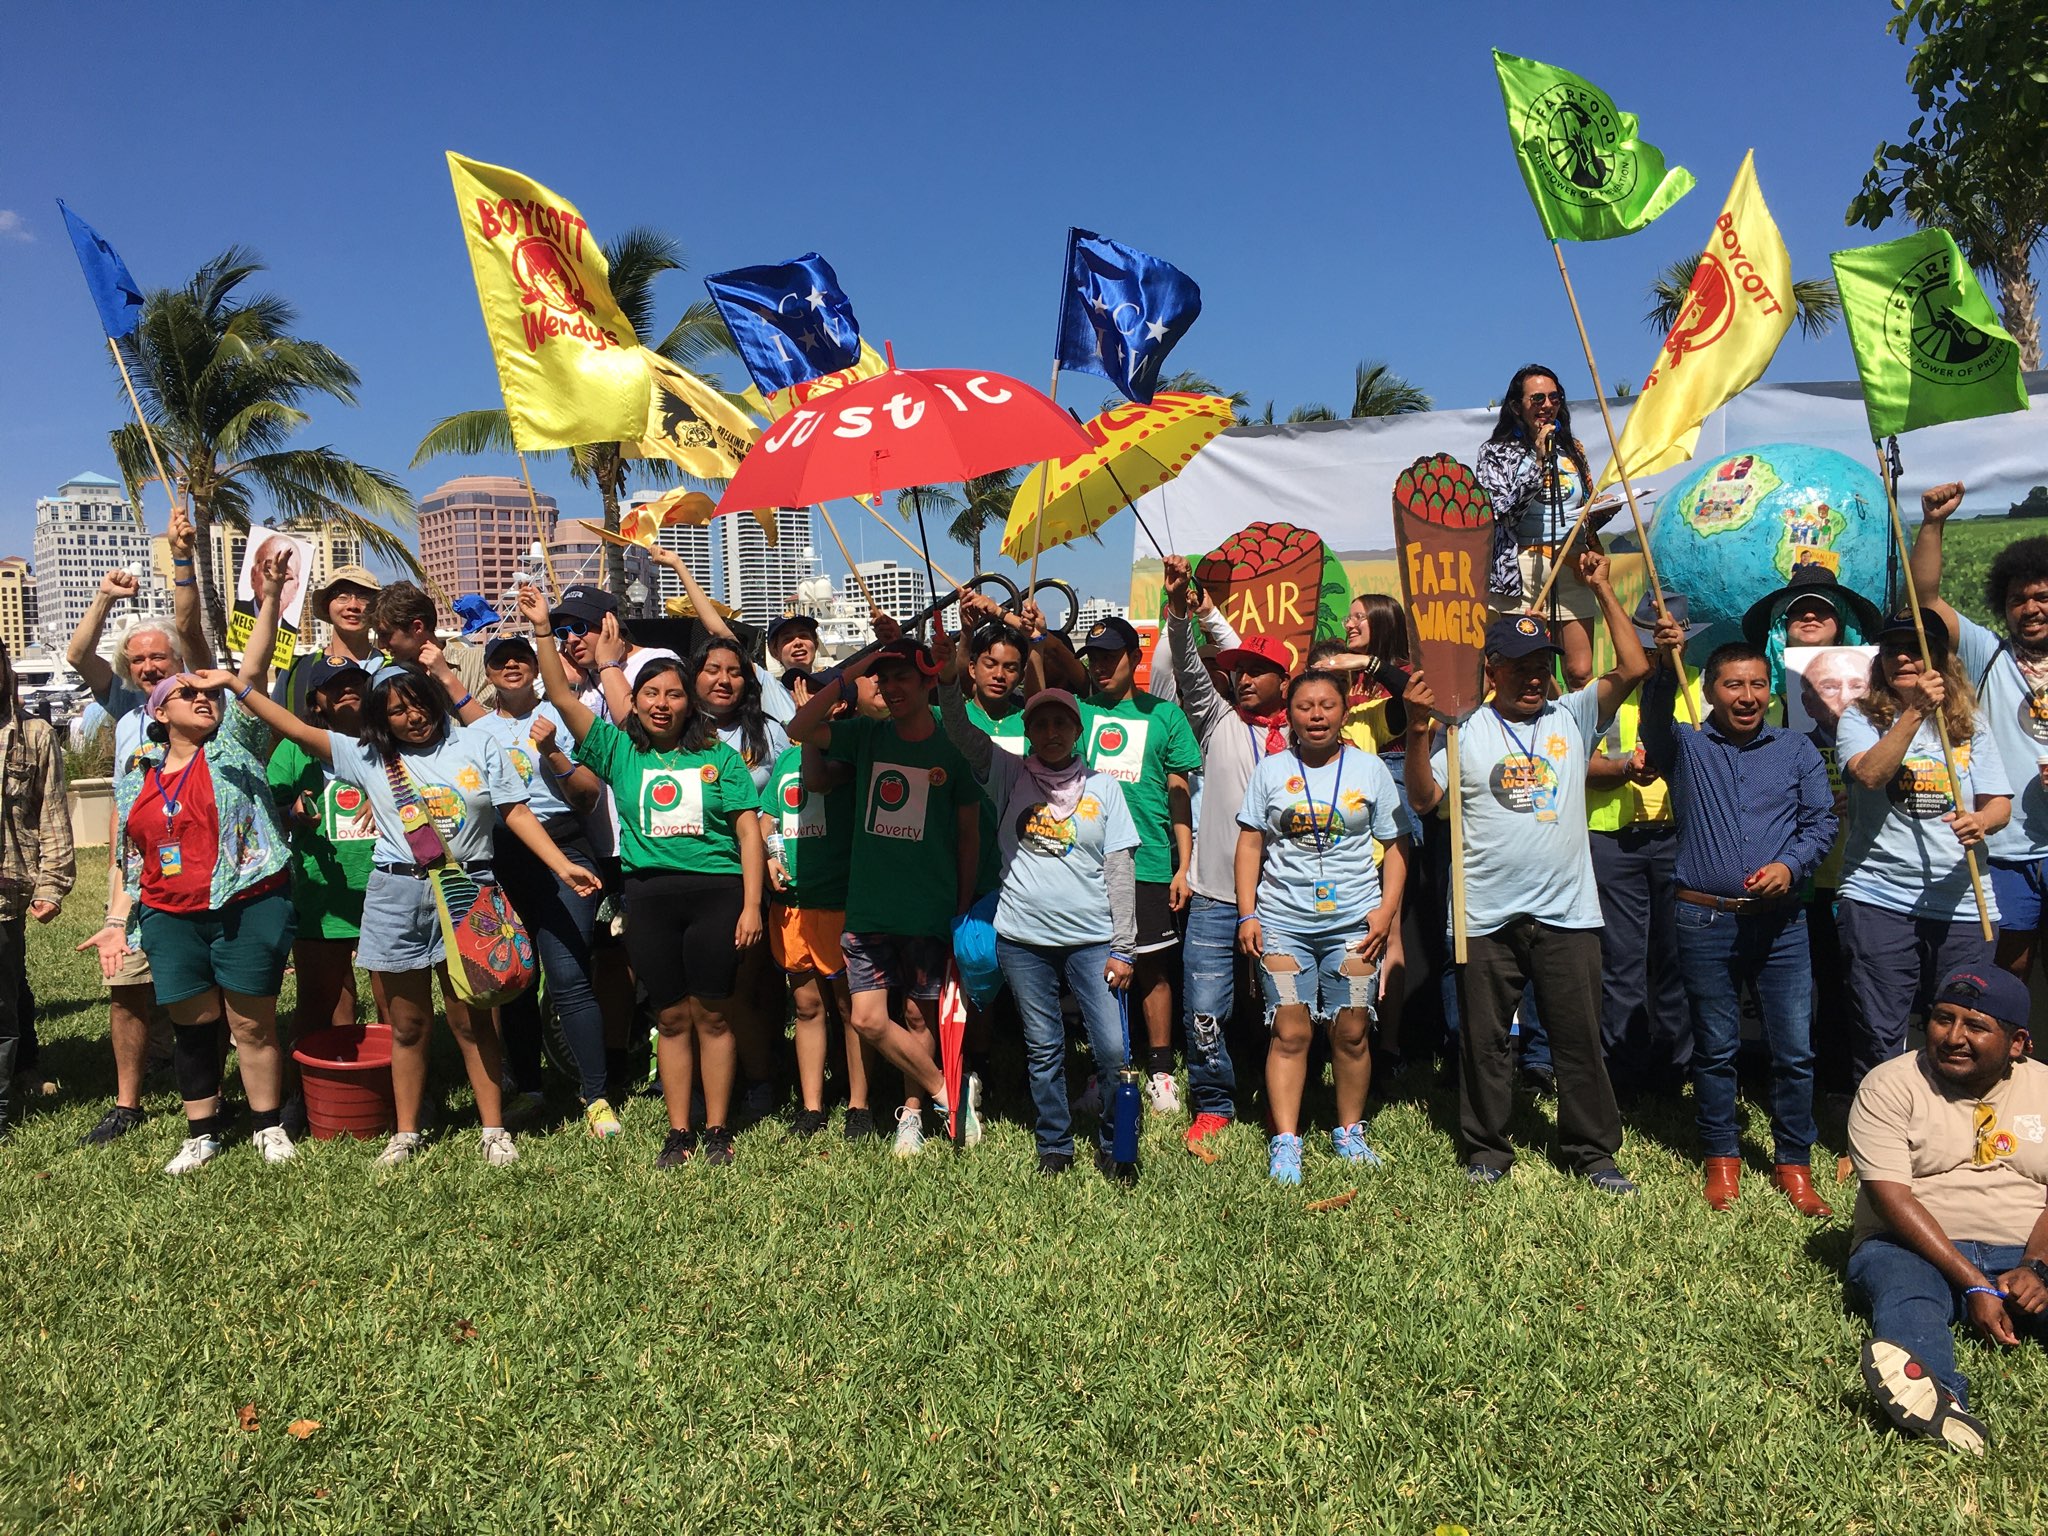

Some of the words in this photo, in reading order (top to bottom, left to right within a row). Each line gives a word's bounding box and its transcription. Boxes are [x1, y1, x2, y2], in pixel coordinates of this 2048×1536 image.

[1534, 149, 1547, 170] THE
[1544, 170, 1577, 197] POWER
[1580, 190, 1596, 199] OF
[476, 198, 588, 263] BOYCOTT
[1716, 211, 1783, 316] BOYCOTT
[1894, 254, 1951, 310] FAIRF
[1112, 302, 1141, 336] C
[1914, 358, 1954, 378] POWER
[1957, 366, 1974, 377] OF
[1976, 340, 2006, 373] PREVEN
[717, 425, 746, 450] BREAKING
[1405, 541, 1476, 598] FAIR
[1219, 581, 1305, 634] FAIR
[1411, 599, 1487, 649] WAGES
[232, 613, 255, 632] NELS
[277, 630, 293, 648] LTZ:
[1504, 768, 1513, 778] A
[1917, 771, 1949, 781] NEW
[430, 805, 459, 817] ORLD
[1025, 823, 1070, 838] WORLD
